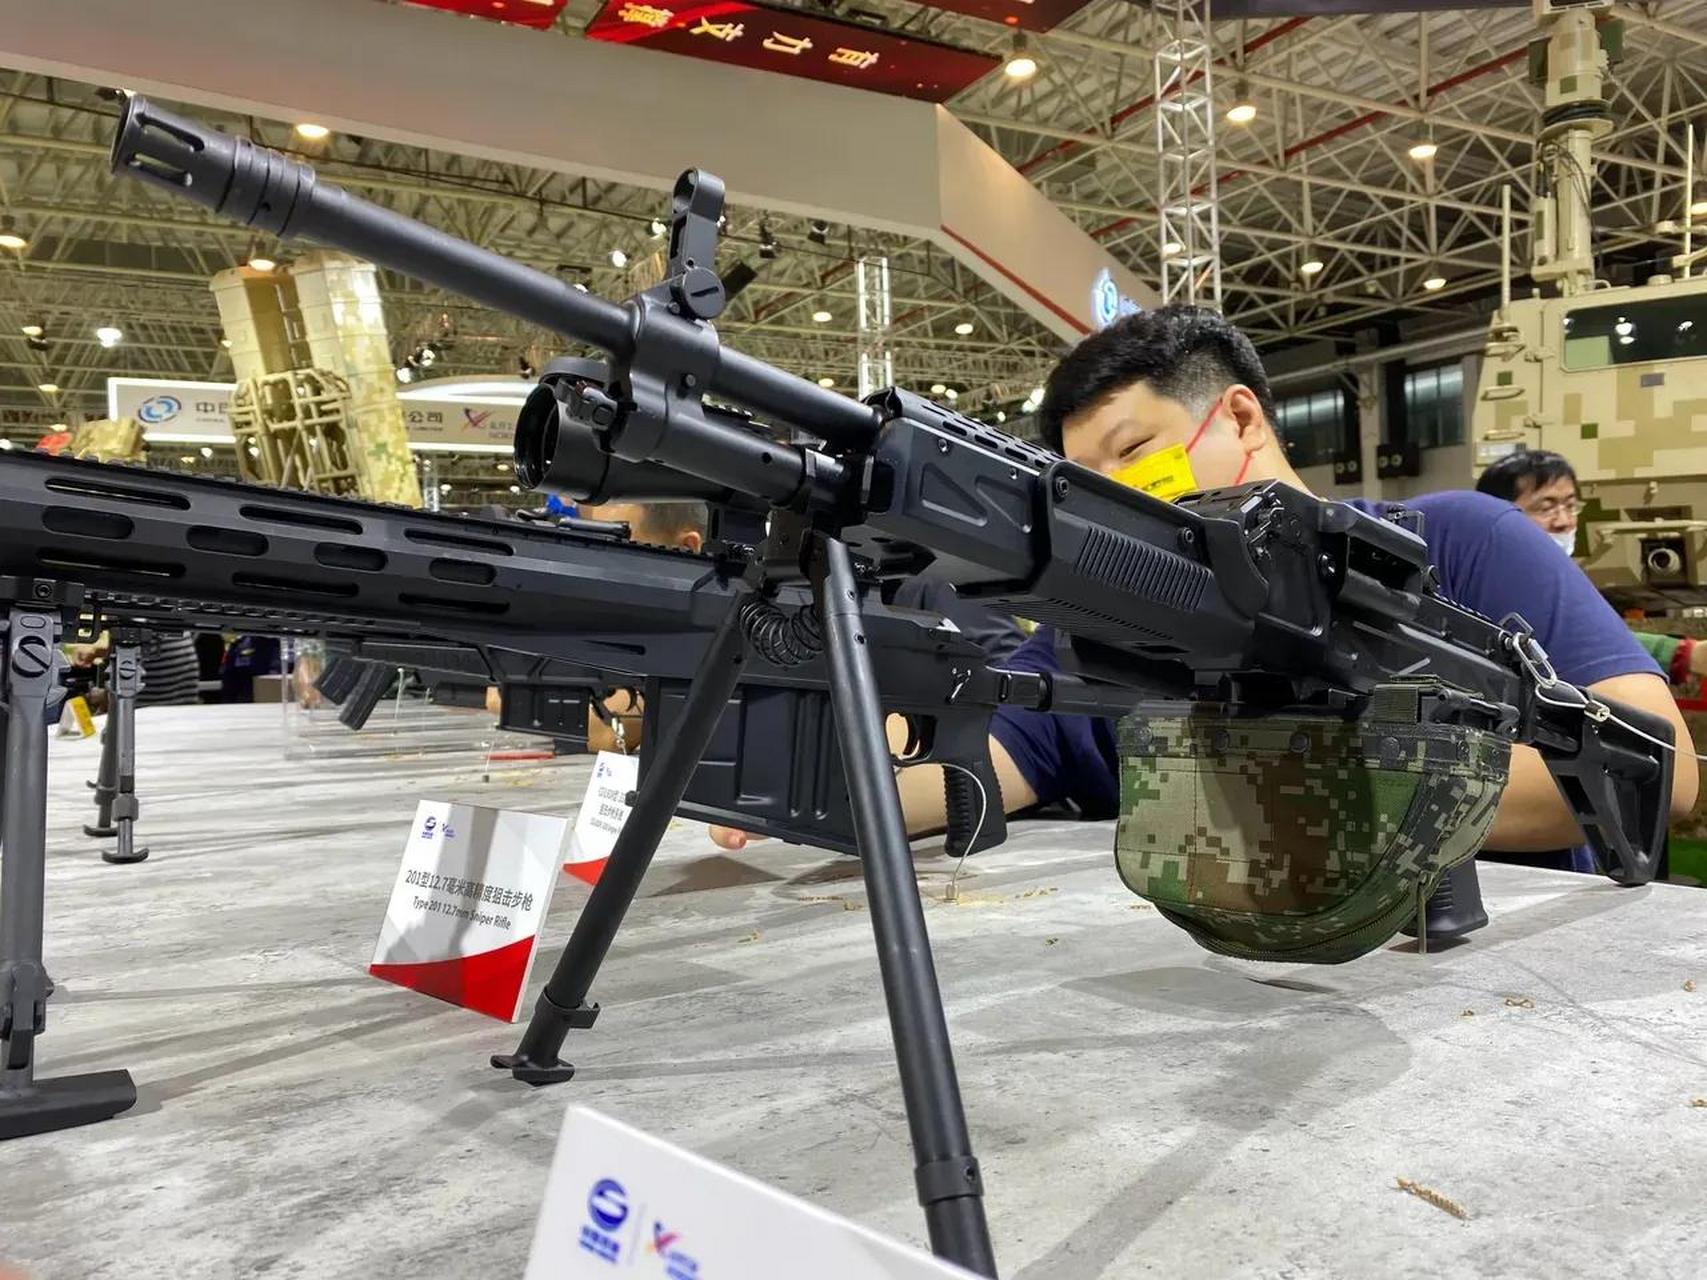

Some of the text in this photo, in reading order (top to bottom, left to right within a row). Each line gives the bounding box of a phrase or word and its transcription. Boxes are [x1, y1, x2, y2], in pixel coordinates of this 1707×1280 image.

[412, 895, 512, 930] Type 201 12.7mm Sniper Rifle
